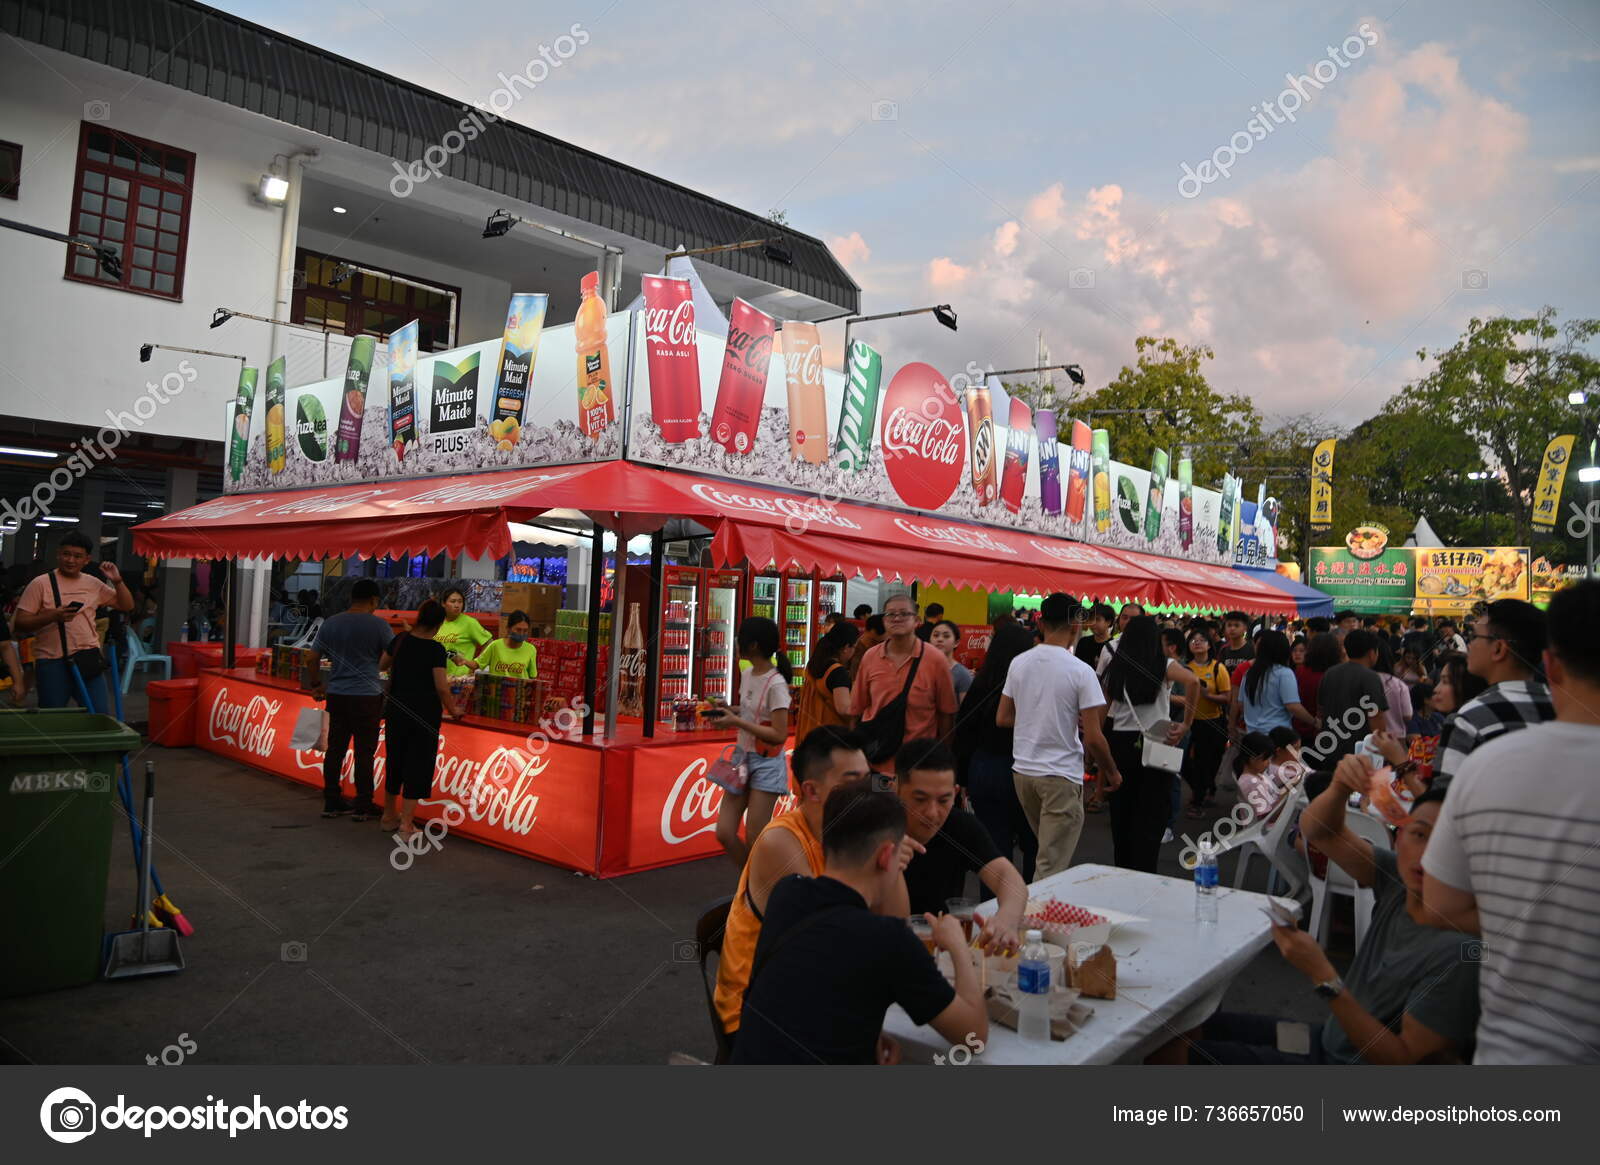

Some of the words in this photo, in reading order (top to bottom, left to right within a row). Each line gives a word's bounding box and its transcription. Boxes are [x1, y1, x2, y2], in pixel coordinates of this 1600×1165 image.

[503, 359, 528, 373] Minute
[504, 371, 523, 384] Maid
[435, 387, 474, 406] Minute
[884, 406, 963, 465] Coca-Cola
[209, 687, 283, 758] Coca-Cola
[9, 769, 87, 795] MBKS
